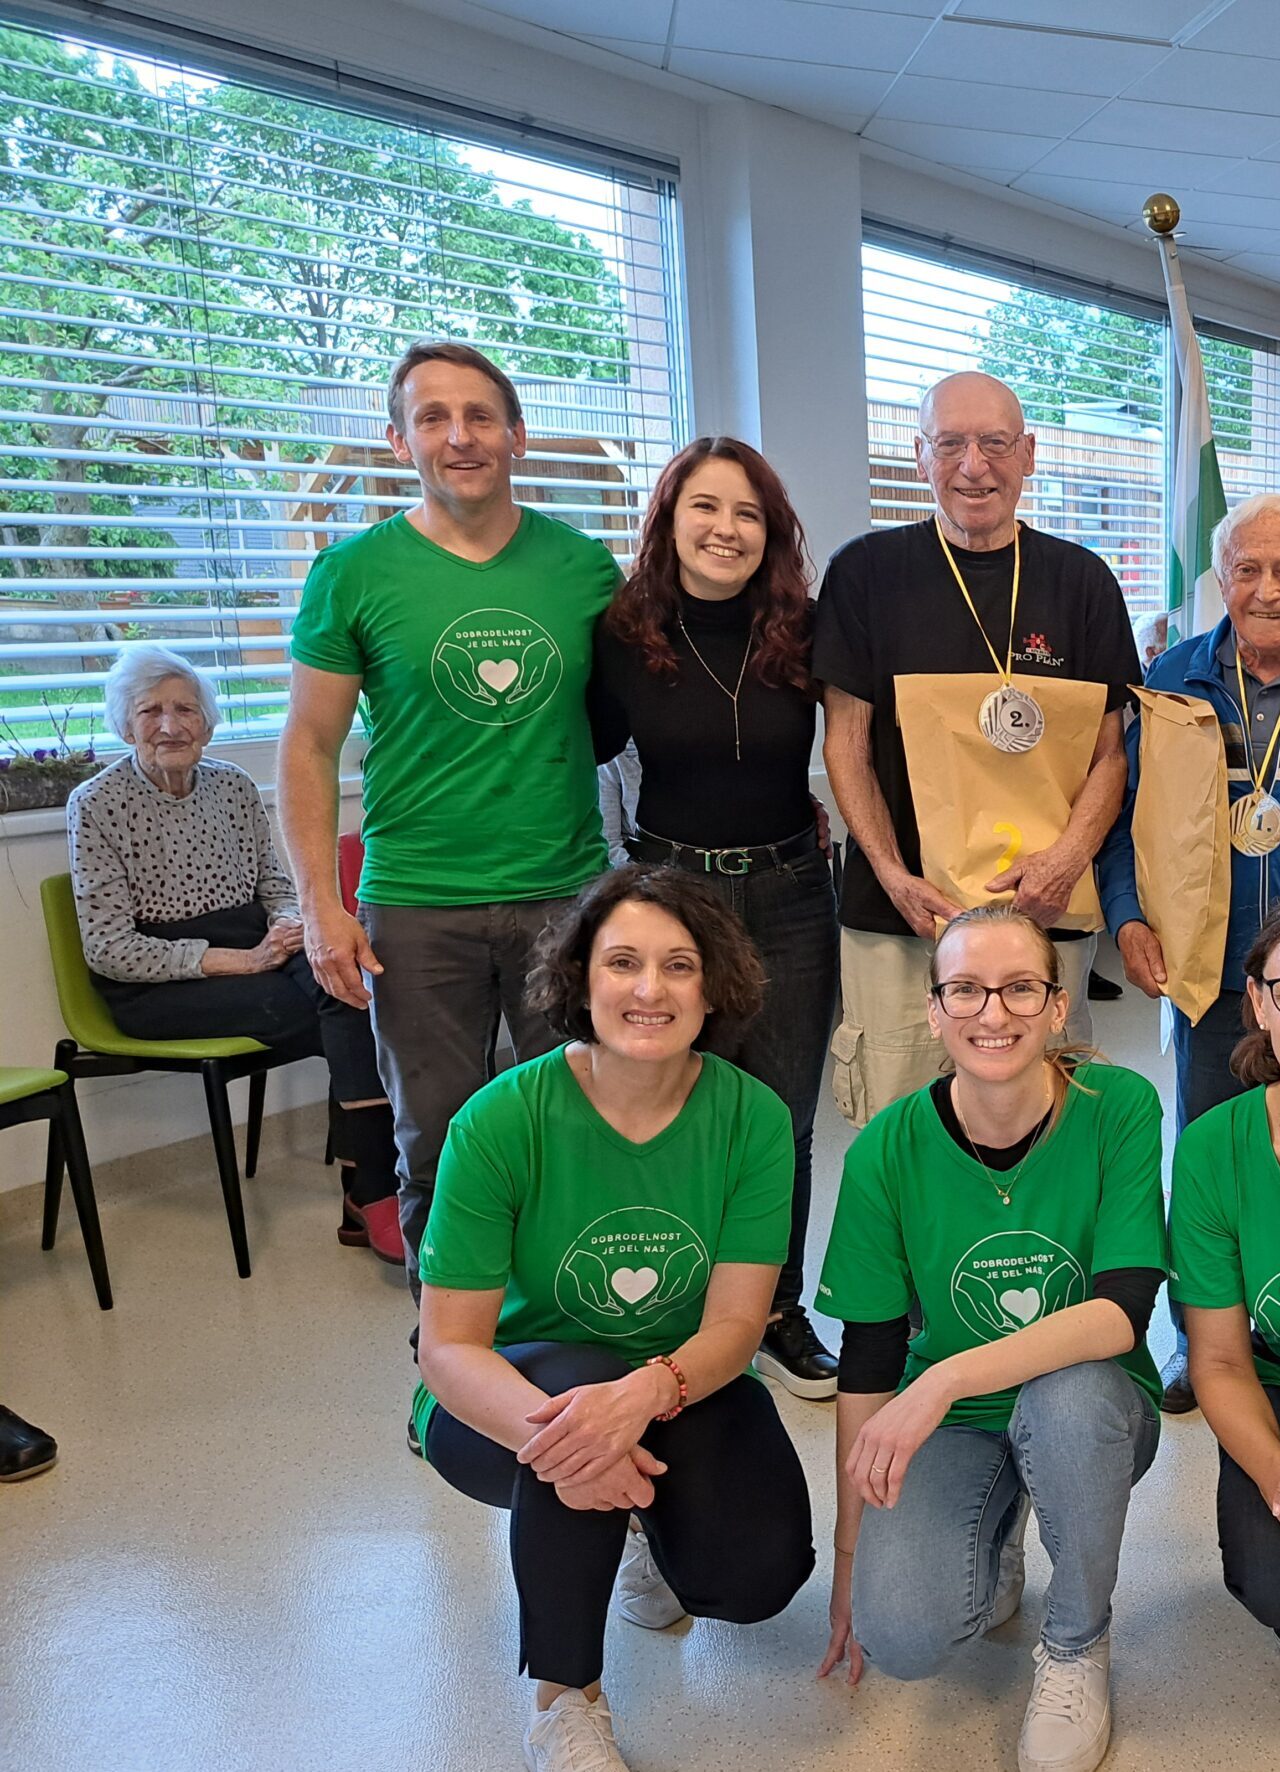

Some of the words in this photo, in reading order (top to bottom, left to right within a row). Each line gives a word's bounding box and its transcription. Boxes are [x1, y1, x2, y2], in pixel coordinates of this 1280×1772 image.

[455, 629, 533, 639] DOBRODELNOST
[467, 641, 478, 649] JE
[481, 640, 499, 648] DEL
[502, 639, 525, 647] NAS.
[1009, 710, 1030, 728] 2.
[1255, 812, 1272, 832] 1.
[591, 1232, 682, 1245] DOBRODELNOST
[602, 1246, 615, 1255] JE
[619, 1244, 639, 1253] DEL
[643, 1245, 669, 1253] NAS.
[972, 1253, 1055, 1269] DOBRODELNOST
[986, 1271, 999, 1280] JE
[1001, 1269, 1023, 1278] DEL
[1025, 1266, 1046, 1276] NAS.
